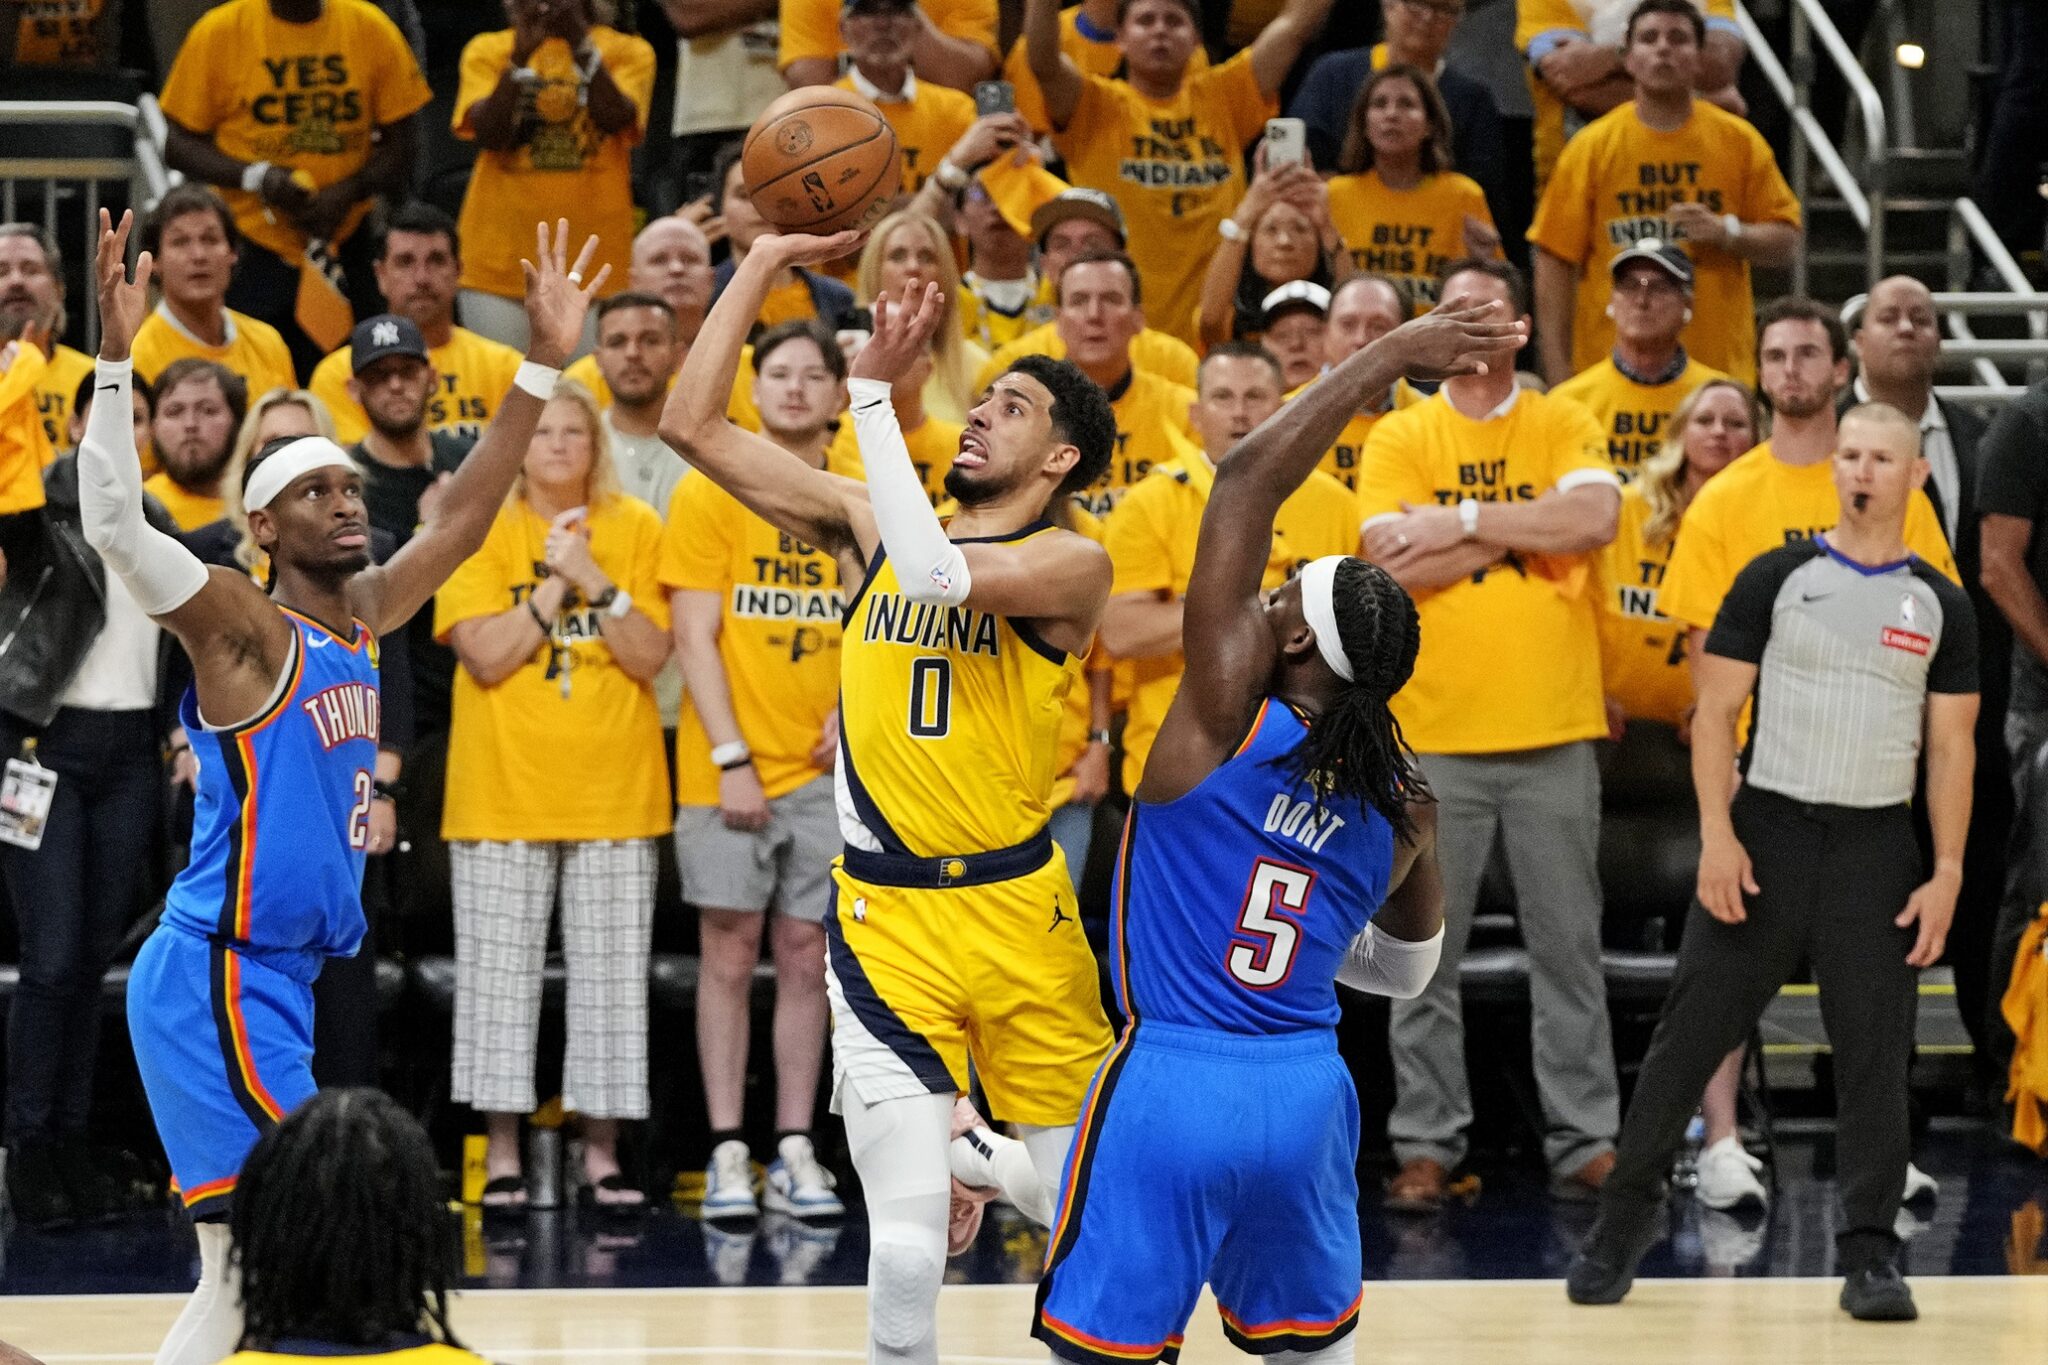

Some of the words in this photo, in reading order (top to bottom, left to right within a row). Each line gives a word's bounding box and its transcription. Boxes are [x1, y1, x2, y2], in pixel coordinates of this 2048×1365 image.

[263, 54, 348, 88] YES
[1639, 162, 1700, 186] BUT
[1373, 223, 1434, 247] BUT
[1350, 249, 1416, 273] THIS
[752, 557, 822, 587] THIS
[863, 593, 999, 657] INDIANA
[303, 682, 379, 751] THUND
[907, 656, 952, 740] 0
[1263, 793, 1345, 853] DORT
[1224, 855, 1319, 992] 5
